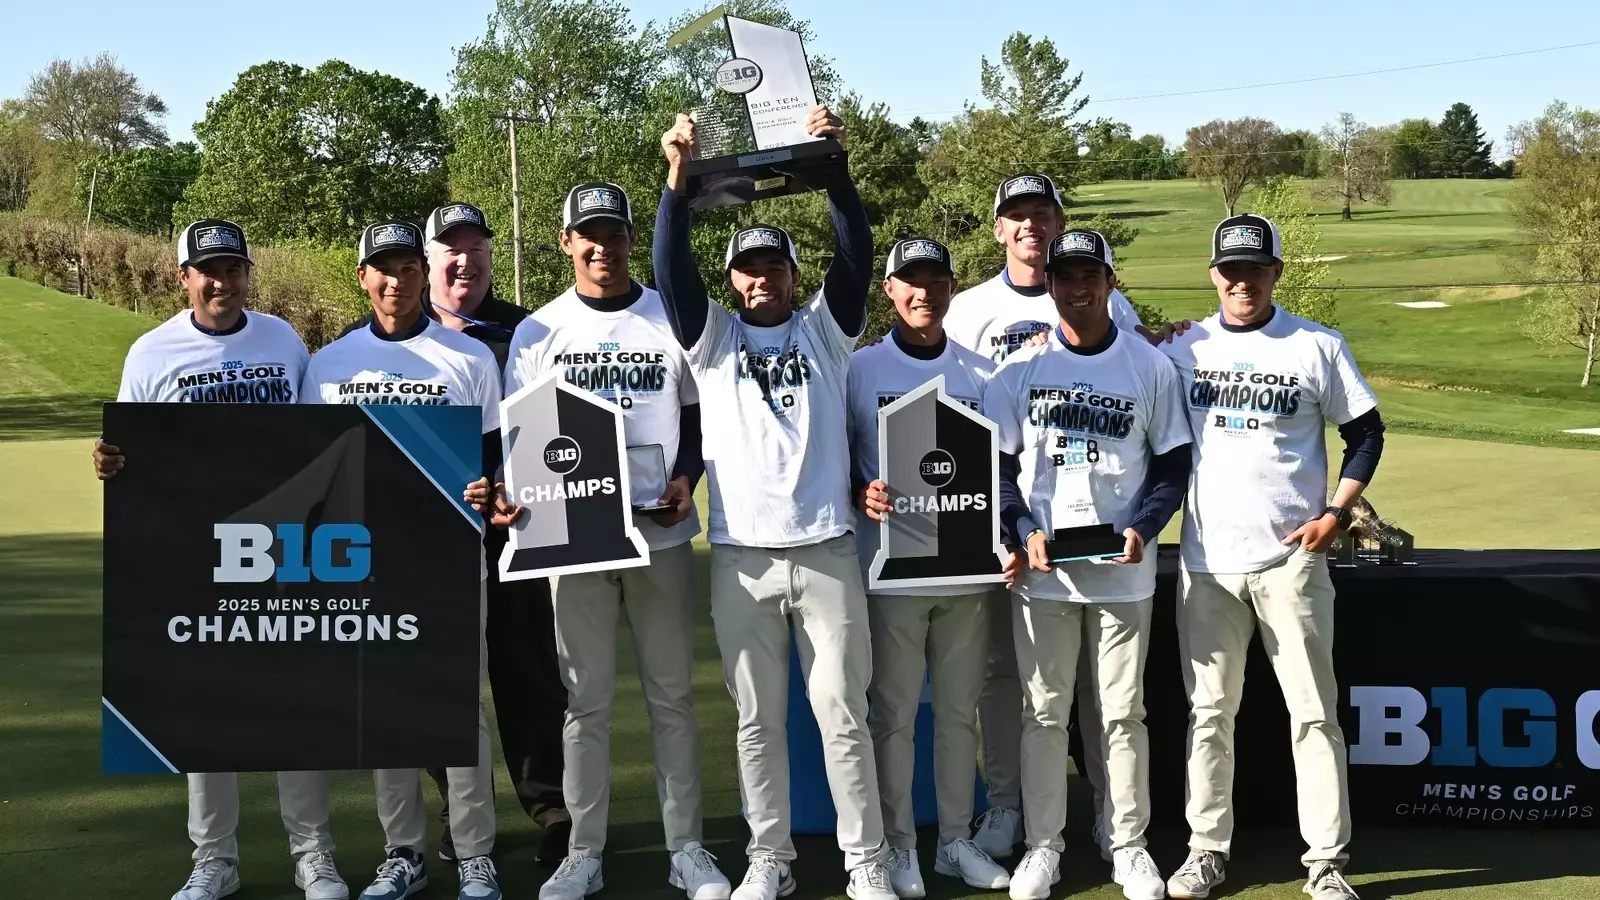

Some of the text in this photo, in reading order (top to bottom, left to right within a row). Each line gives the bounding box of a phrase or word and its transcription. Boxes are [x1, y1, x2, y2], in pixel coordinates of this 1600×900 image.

[751, 96, 799, 109] BIG TEN
[753, 102, 808, 115] CONFERENCE
[598, 343, 620, 351] 2025
[221, 361, 243, 370] 2025
[554, 352, 664, 365] MEN'S GOLF
[1233, 362, 1254, 371] 2025
[177, 367, 286, 388] MEN'S GOLF
[381, 373, 403, 381] 2025
[564, 365, 668, 391] HAMPIONS
[1193, 369, 1299, 387] MEN'S GOLF
[339, 382, 447, 396] MEN'S GOLF
[1072, 382, 1093, 392] 2025
[1029, 389, 1134, 412] MEN'S GOLF
[1190, 380, 1301, 416] CHAMPIONS
[1028, 401, 1135, 439] CHAMPIONS
[520, 477, 616, 504] CHAMPS
[894, 493, 987, 514] CHAMPS
[218, 598, 371, 611] 2025 MEN'S GOLF
[167, 613, 420, 643] CHAMPIONS
[1423, 783, 1576, 801] MEN'S GOLF
[1395, 803, 1593, 821] CHAMPIONSHIPS
